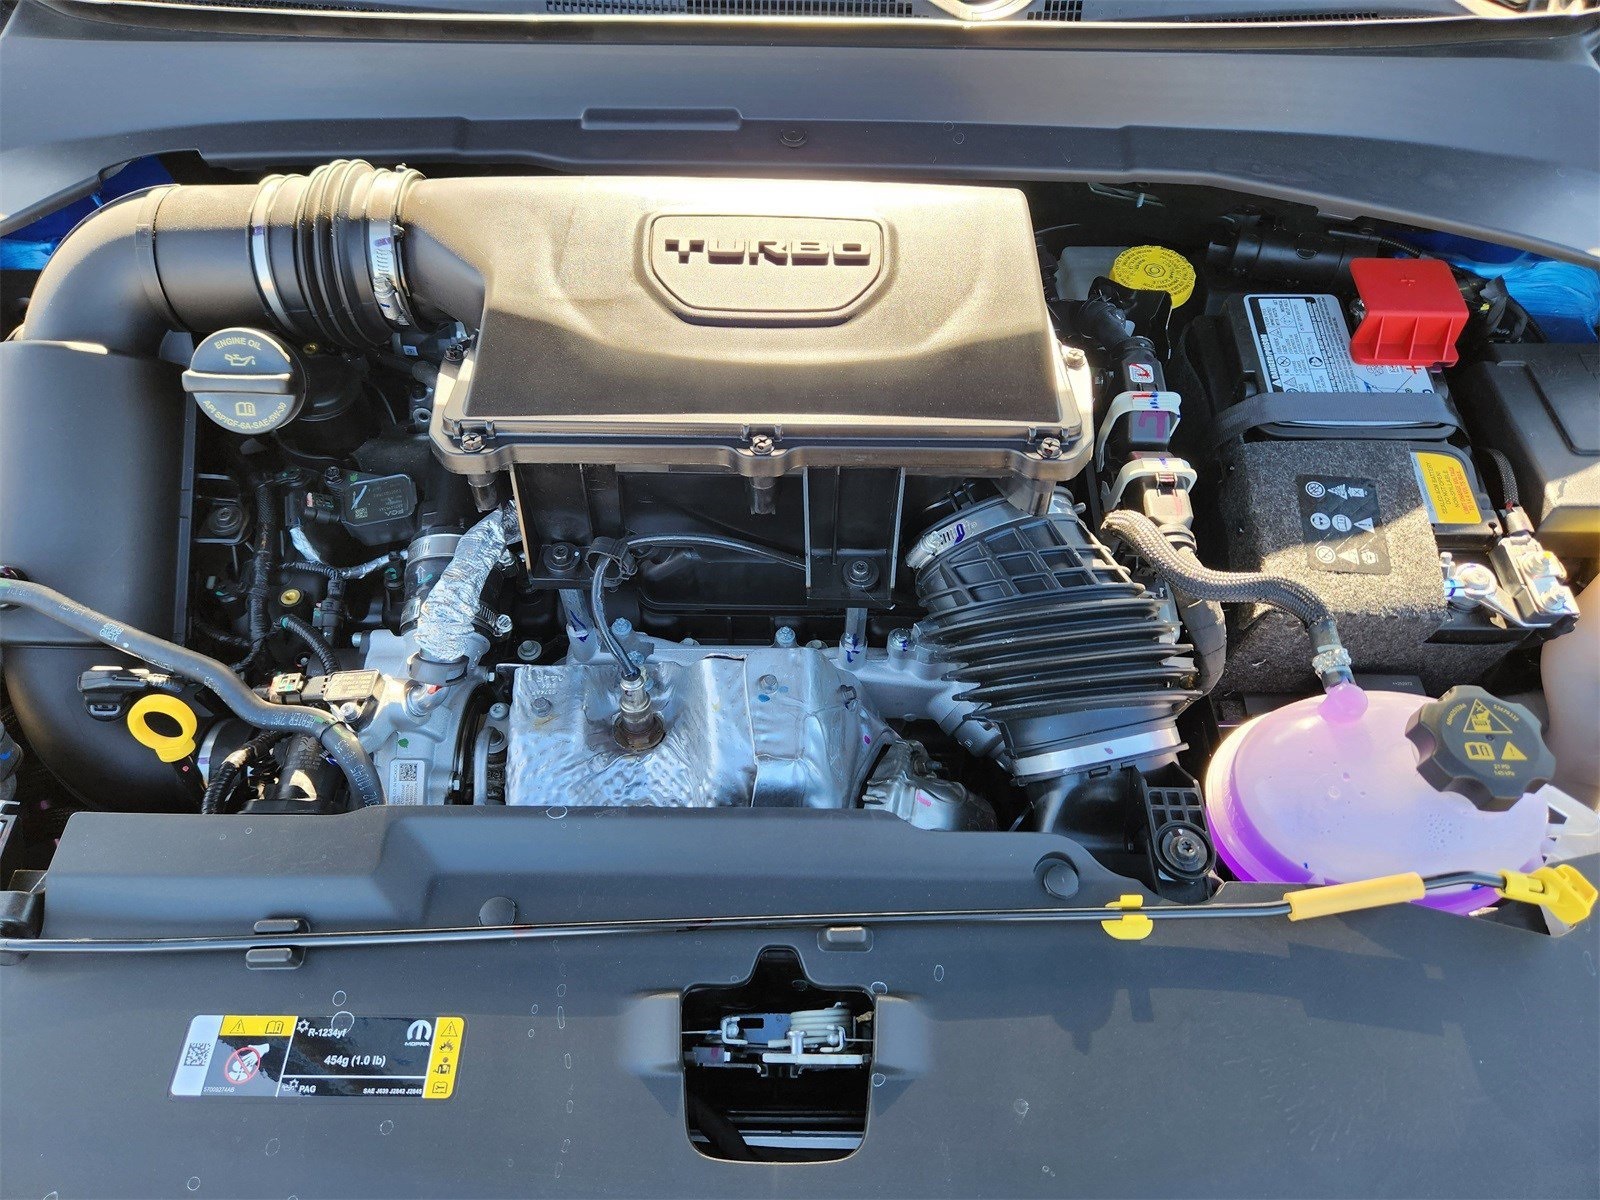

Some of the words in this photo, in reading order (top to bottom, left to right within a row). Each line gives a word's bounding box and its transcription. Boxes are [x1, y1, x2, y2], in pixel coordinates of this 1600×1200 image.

[664, 238, 871, 267] TURBO
[215, 337, 247, 350] ENGINE
[248, 339, 262, 351] OIL
[203, 401, 215, 412] API
[307, 1028, 348, 1039] R-1234yf
[324, 1055, 350, 1067] 454g
[351, 1055, 371, 1067] (1.0
[372, 1055, 387, 1067] lb)
[299, 1084, 316, 1094] PAG
[362, 1087, 375, 1095] SAE
